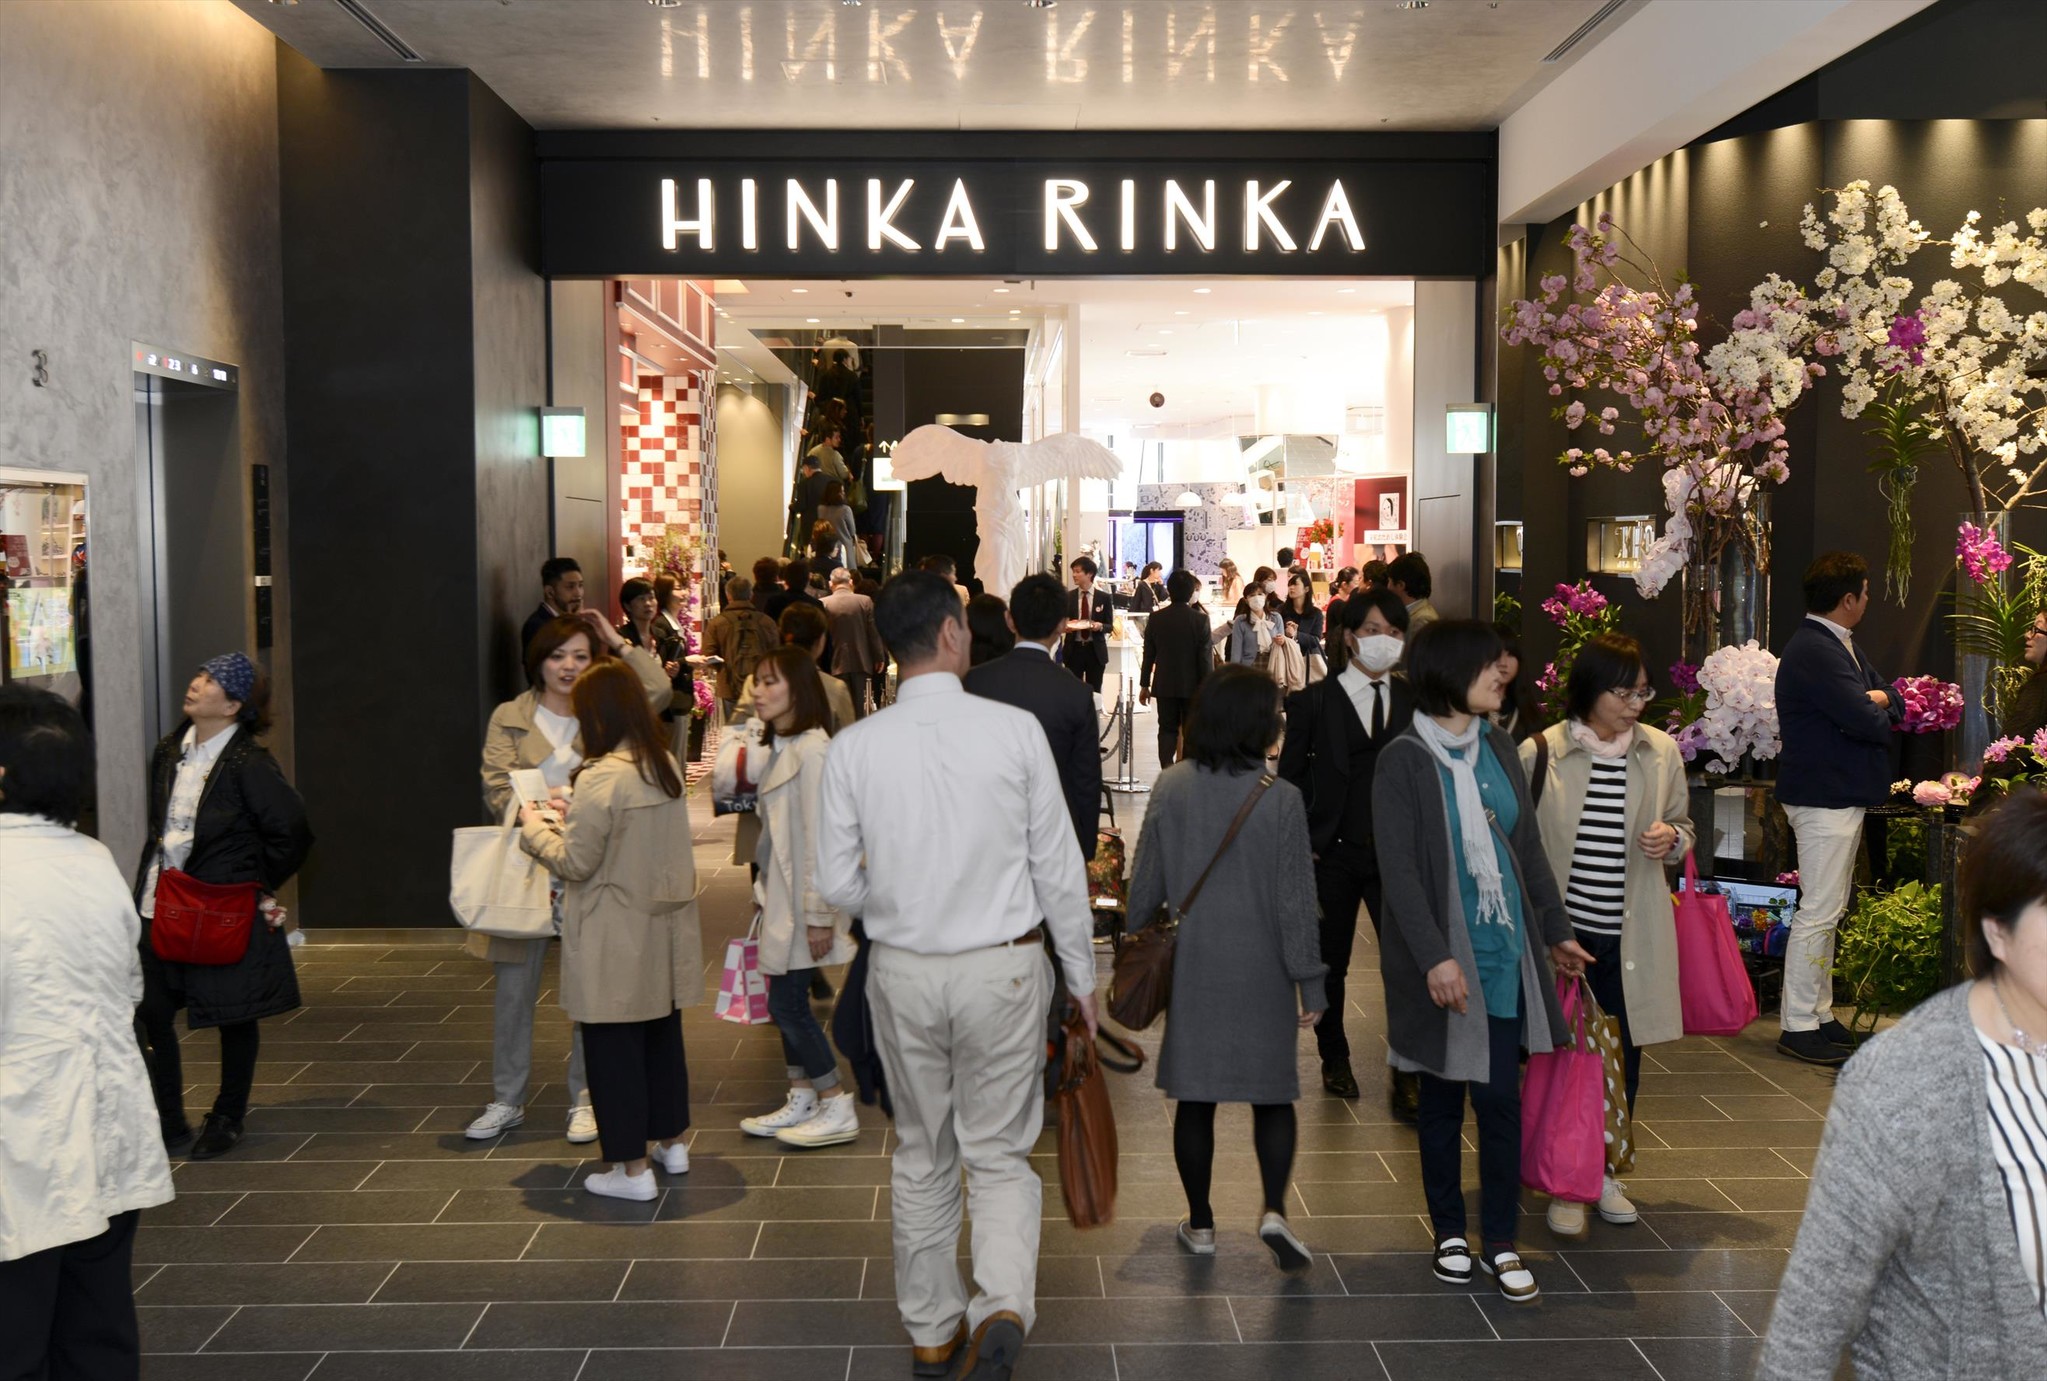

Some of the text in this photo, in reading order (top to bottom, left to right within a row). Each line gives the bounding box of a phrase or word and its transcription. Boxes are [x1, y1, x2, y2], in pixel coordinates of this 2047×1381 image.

[661, 177, 1366, 251] HINKA RINKA
[31, 349, 48, 388] 3
